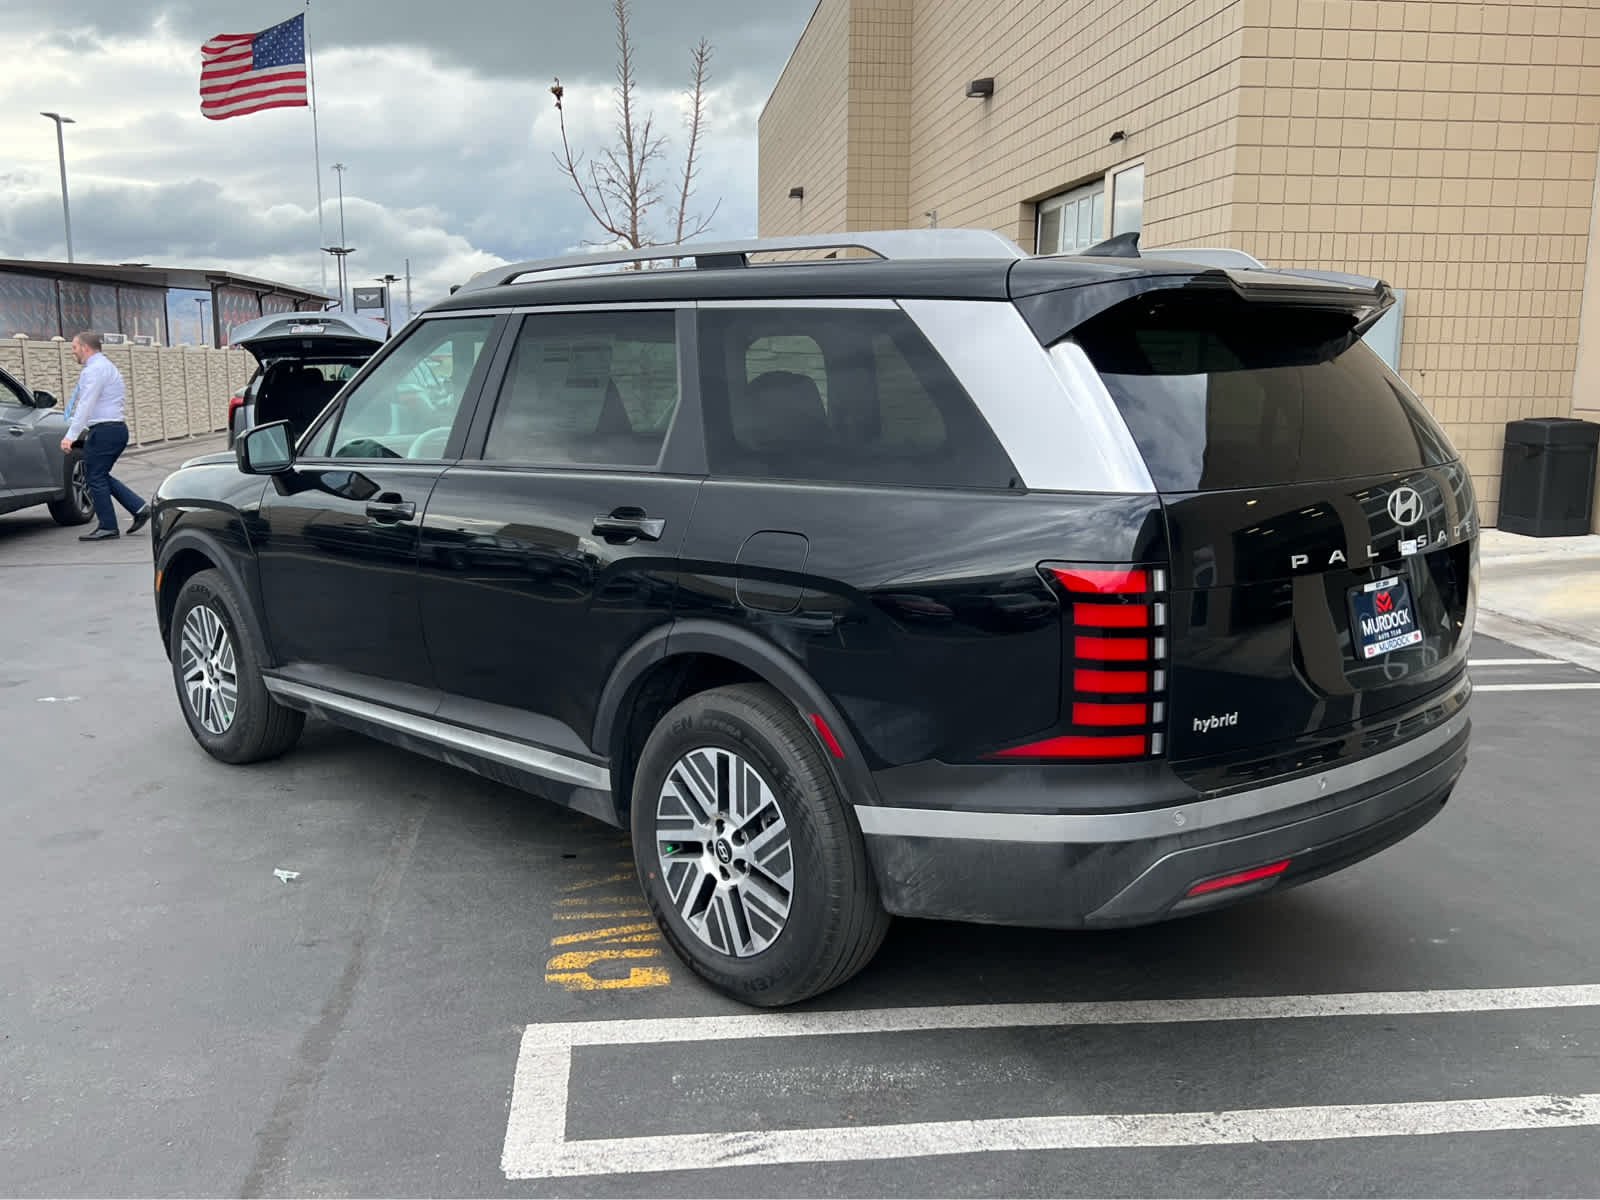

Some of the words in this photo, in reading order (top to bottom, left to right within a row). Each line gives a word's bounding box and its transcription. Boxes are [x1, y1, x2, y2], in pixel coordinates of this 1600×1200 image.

[1362, 608, 1411, 637] MURDOCK
[1379, 636, 1410, 651] MURDOCK
[1193, 711, 1238, 733] hybrid
